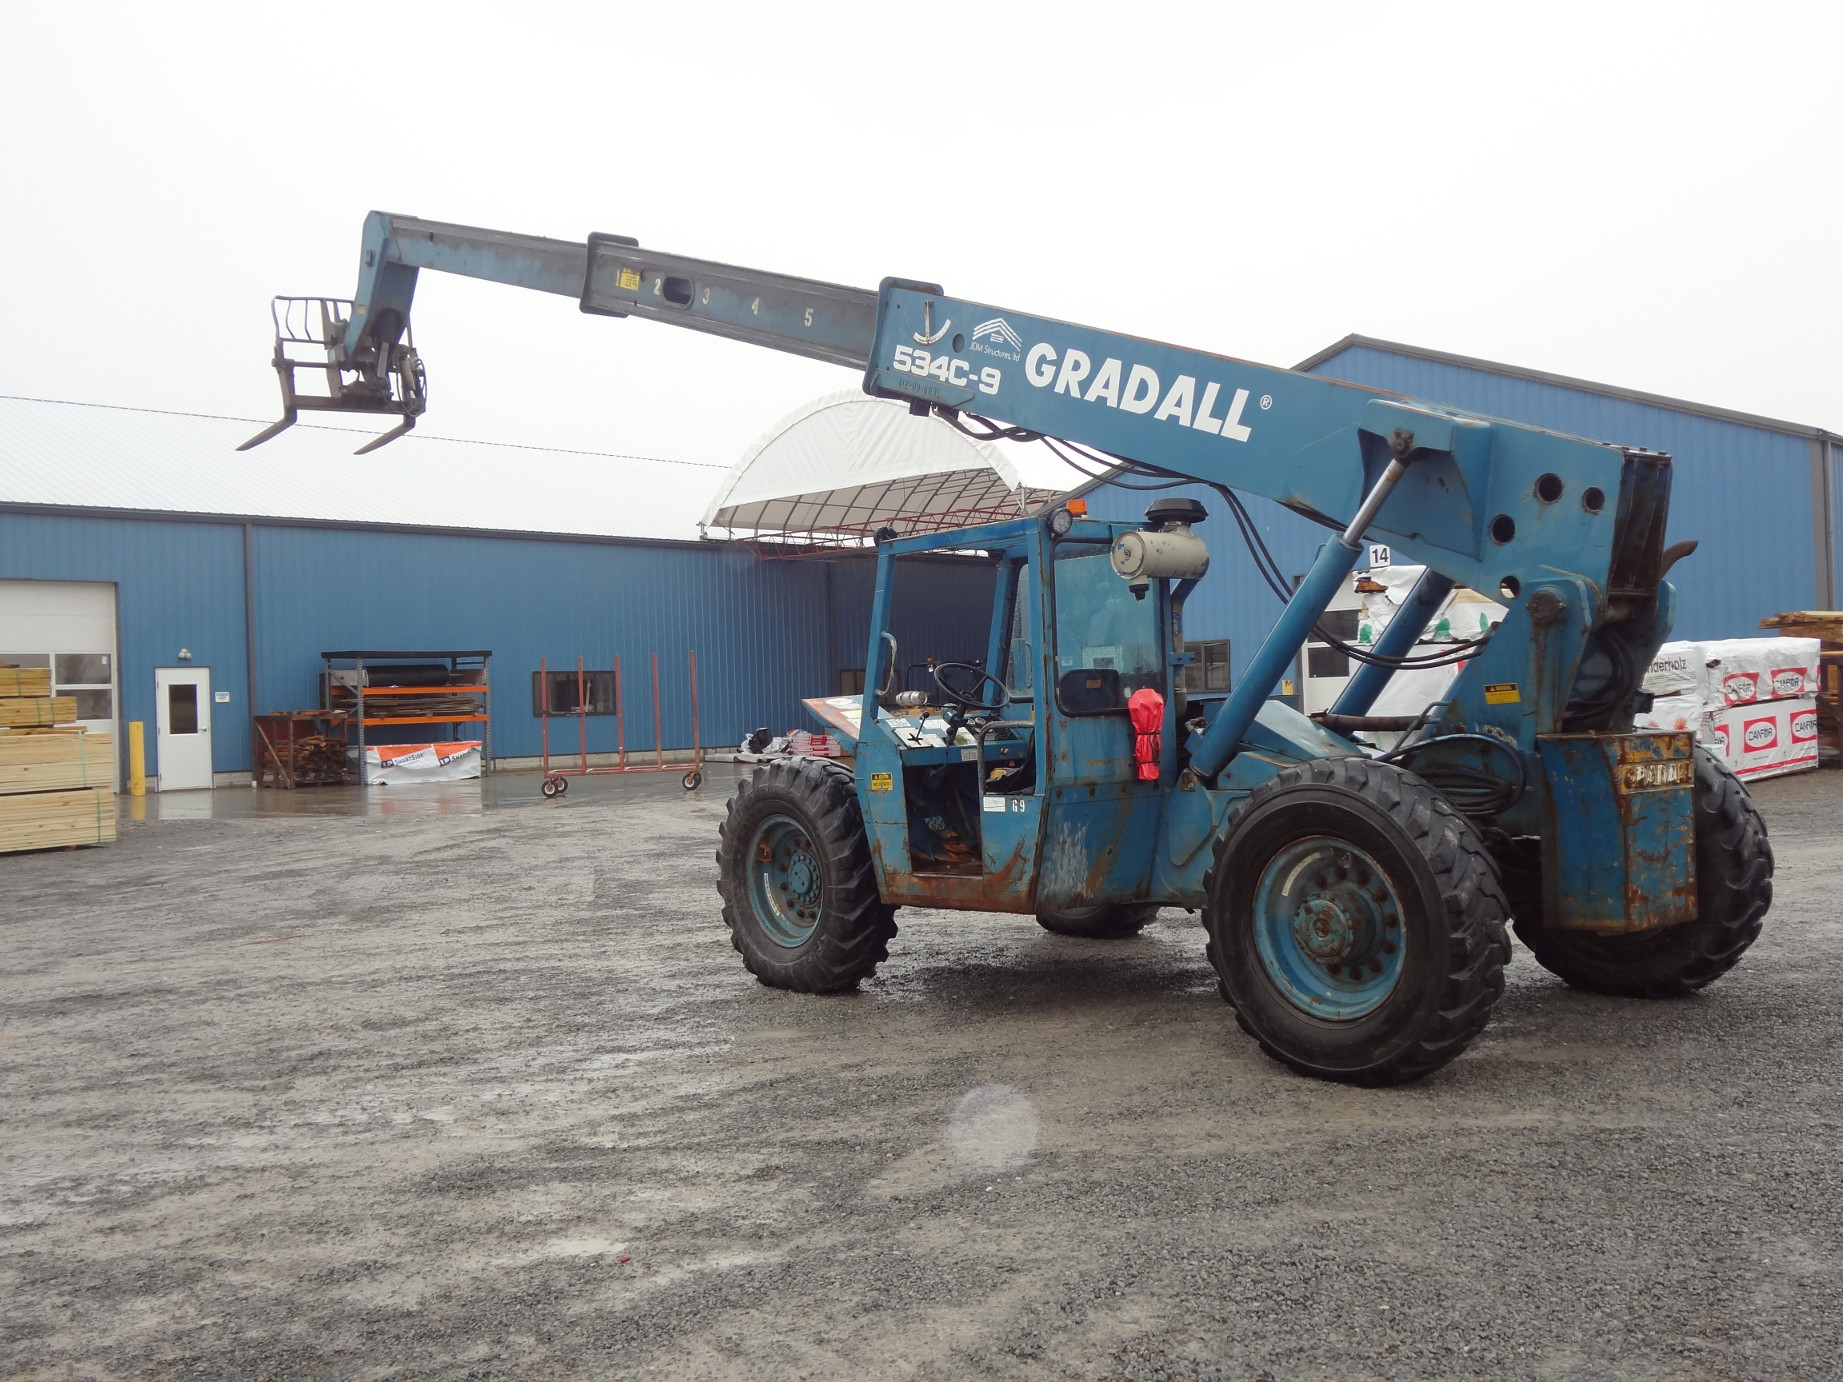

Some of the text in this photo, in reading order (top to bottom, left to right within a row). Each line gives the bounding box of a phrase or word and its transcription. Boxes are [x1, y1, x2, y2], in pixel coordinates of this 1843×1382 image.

[653, 278, 662, 296] 2
[702, 287, 710, 305] 3
[751, 297, 760, 315] 4
[804, 308, 814, 327] 5
[970, 341, 983, 352] JDM
[892, 344, 1001, 395] 534C-9
[1025, 342, 1252, 443] GRADALL
[1372, 547, 1389, 564] 14
[1648, 657, 1687, 674] nderholz
[1748, 727, 1773, 742] CANFOR
